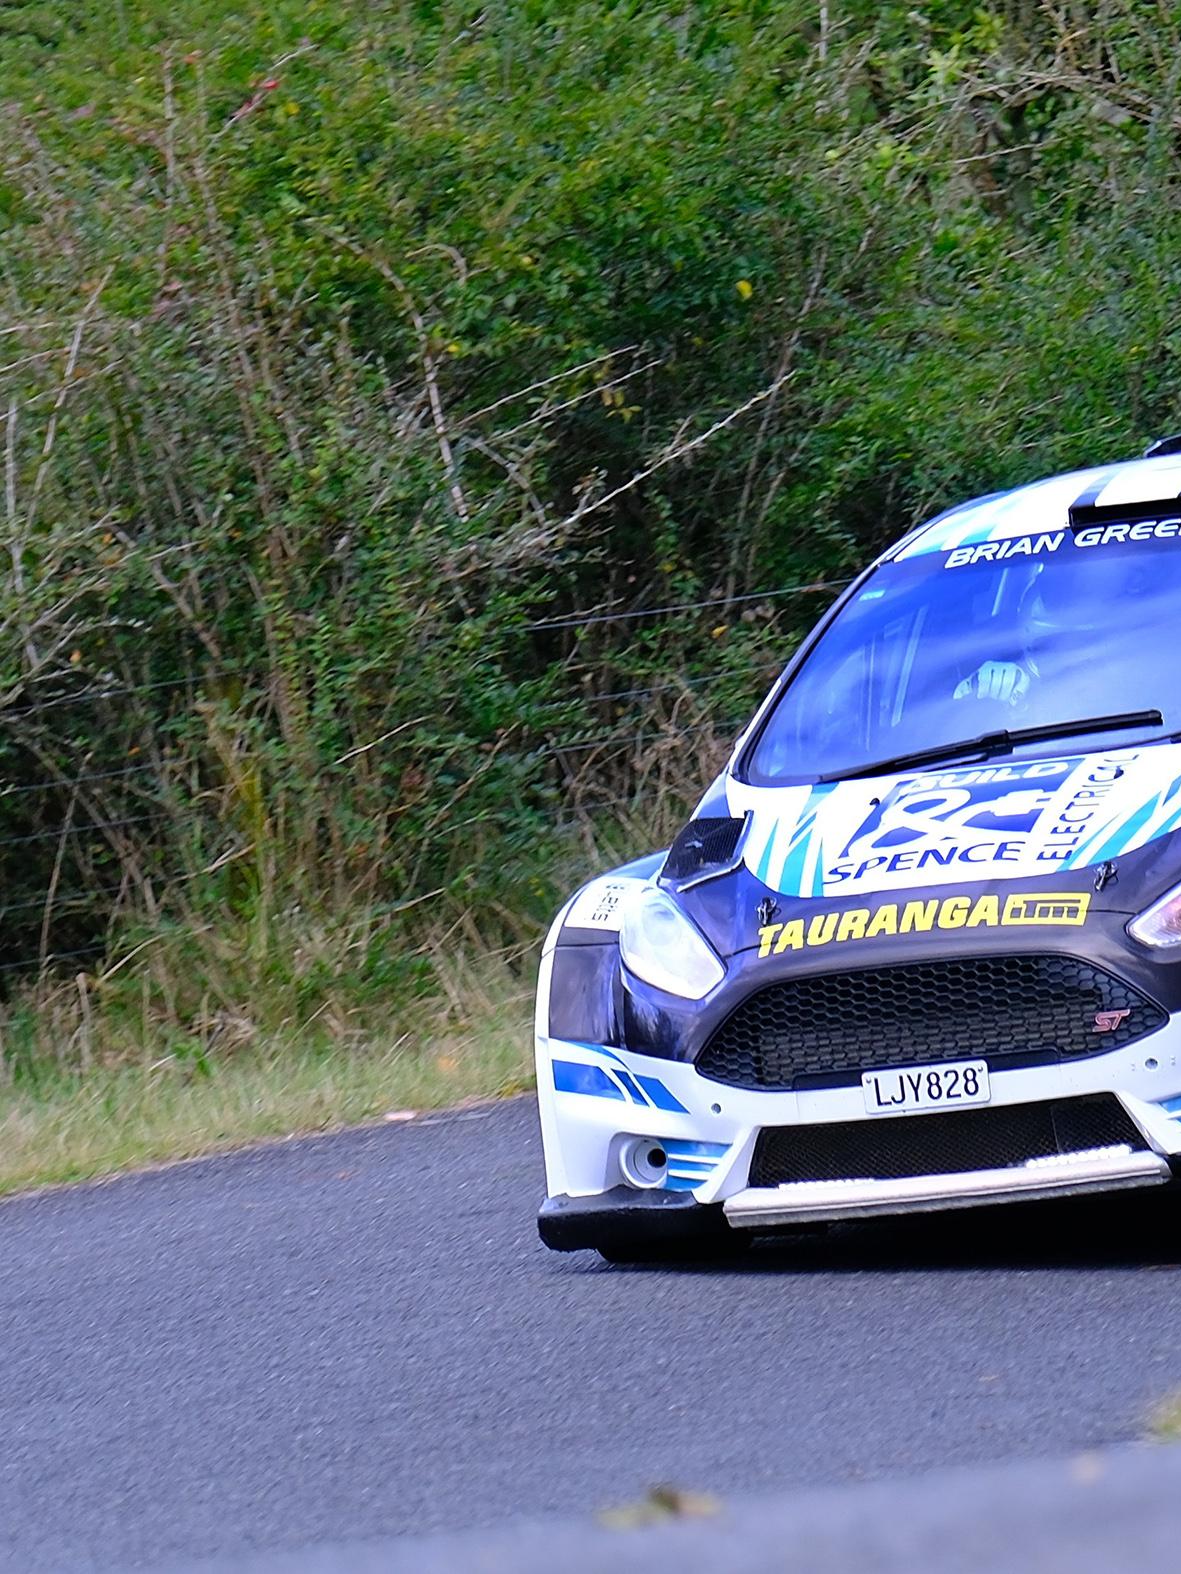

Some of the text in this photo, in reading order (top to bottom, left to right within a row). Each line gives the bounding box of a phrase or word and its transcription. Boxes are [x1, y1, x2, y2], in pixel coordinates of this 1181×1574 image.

[944, 532, 1064, 569] BRIAN
[902, 761, 1071, 792] BUILD
[822, 841, 1026, 886] SPENCE
[757, 895, 999, 959] TAURANGA
[1093, 1008, 1131, 1033] ST
[873, 1067, 980, 1107] LJY828
